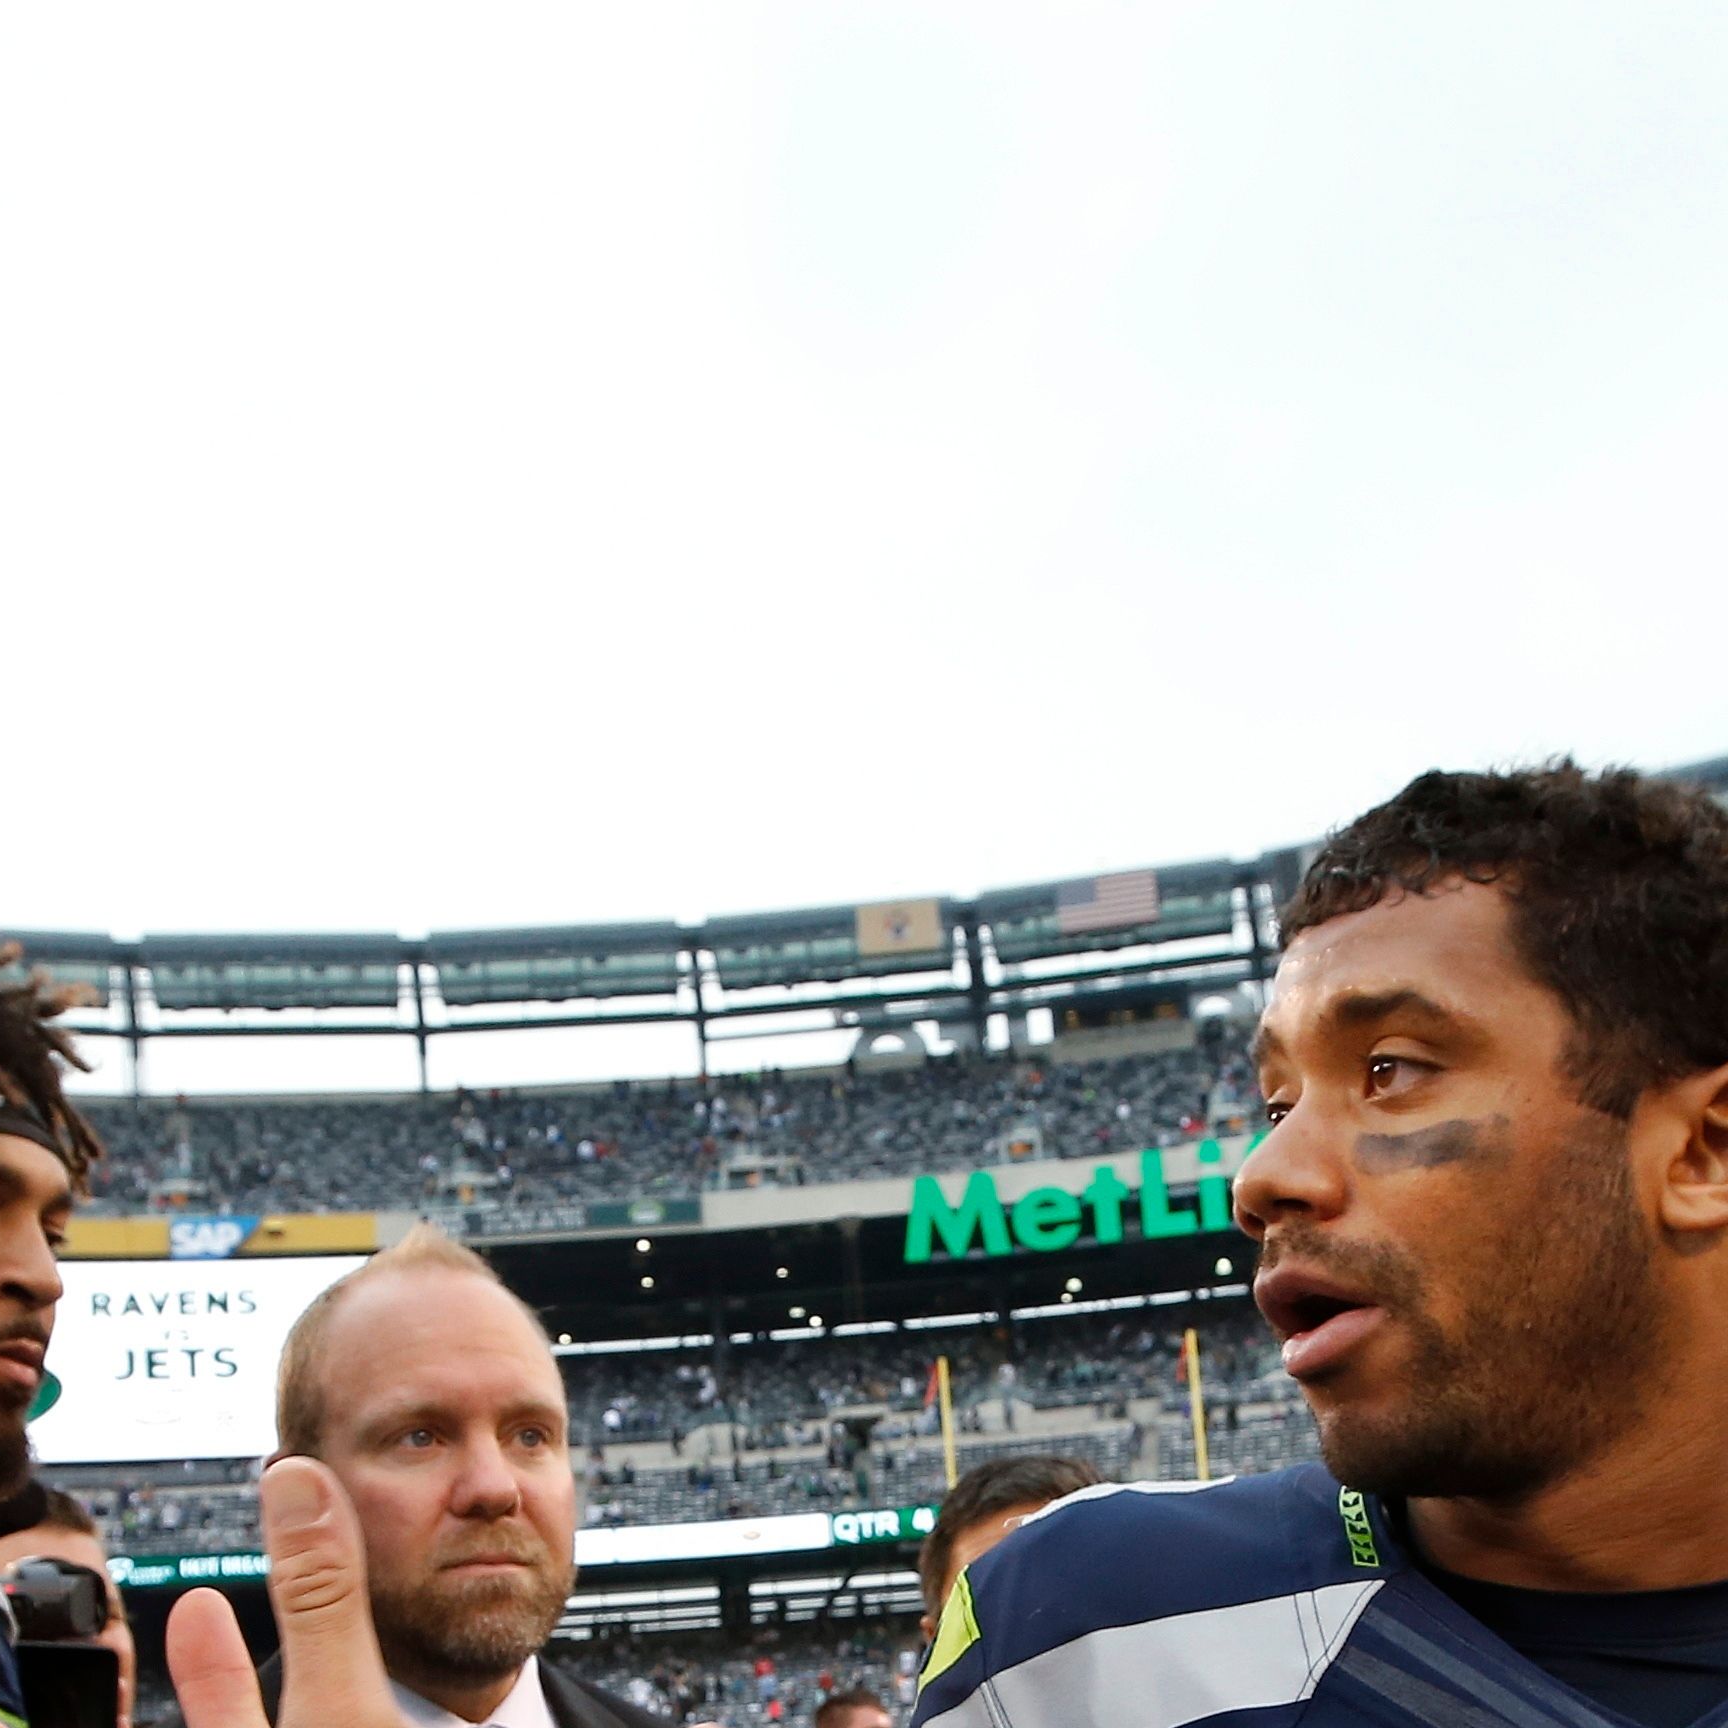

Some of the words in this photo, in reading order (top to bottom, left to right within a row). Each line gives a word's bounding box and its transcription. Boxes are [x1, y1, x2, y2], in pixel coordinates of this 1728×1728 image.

[904, 1132, 1264, 1264] MetLi
[171, 1222, 243, 1259] SAP
[92, 1289, 257, 1317] RAVENS
[115, 1347, 238, 1381] JETS
[833, 1510, 900, 1544] QTR
